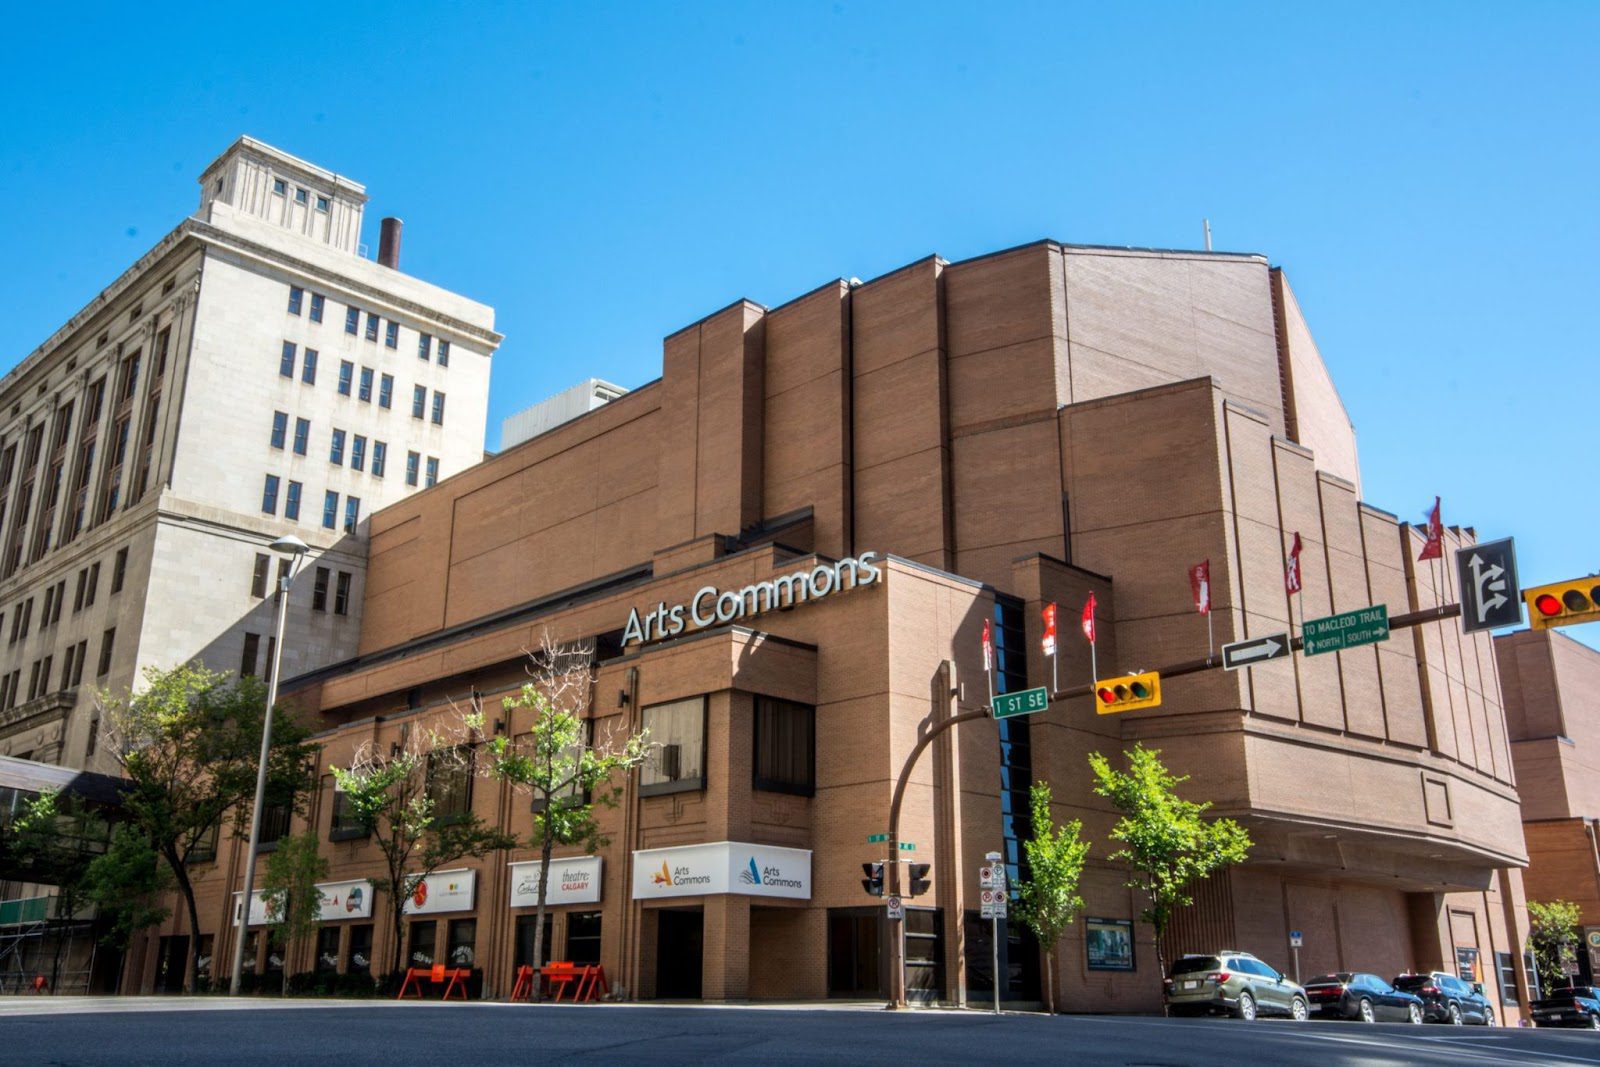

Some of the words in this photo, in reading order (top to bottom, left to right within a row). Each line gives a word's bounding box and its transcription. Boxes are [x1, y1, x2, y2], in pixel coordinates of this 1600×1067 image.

[620, 601, 686, 647] Arts
[691, 551, 881, 627] Commons
[1304, 624, 1315, 636] TO
[1318, 616, 1357, 634] MACLEOD
[1360, 610, 1384, 624] TRAIL
[1316, 637, 1340, 650] NORTH
[1347, 631, 1372, 643] SOUTH
[996, 702, 1001, 714] 1
[1008, 697, 1022, 712] ST
[1028, 693, 1044, 708] SE
[674, 866, 689, 876] Arts
[763, 866, 780, 877] Arts
[561, 881, 589, 891] CALGARY
[673, 875, 711, 886] Commons
[763, 876, 802, 889] Commons
